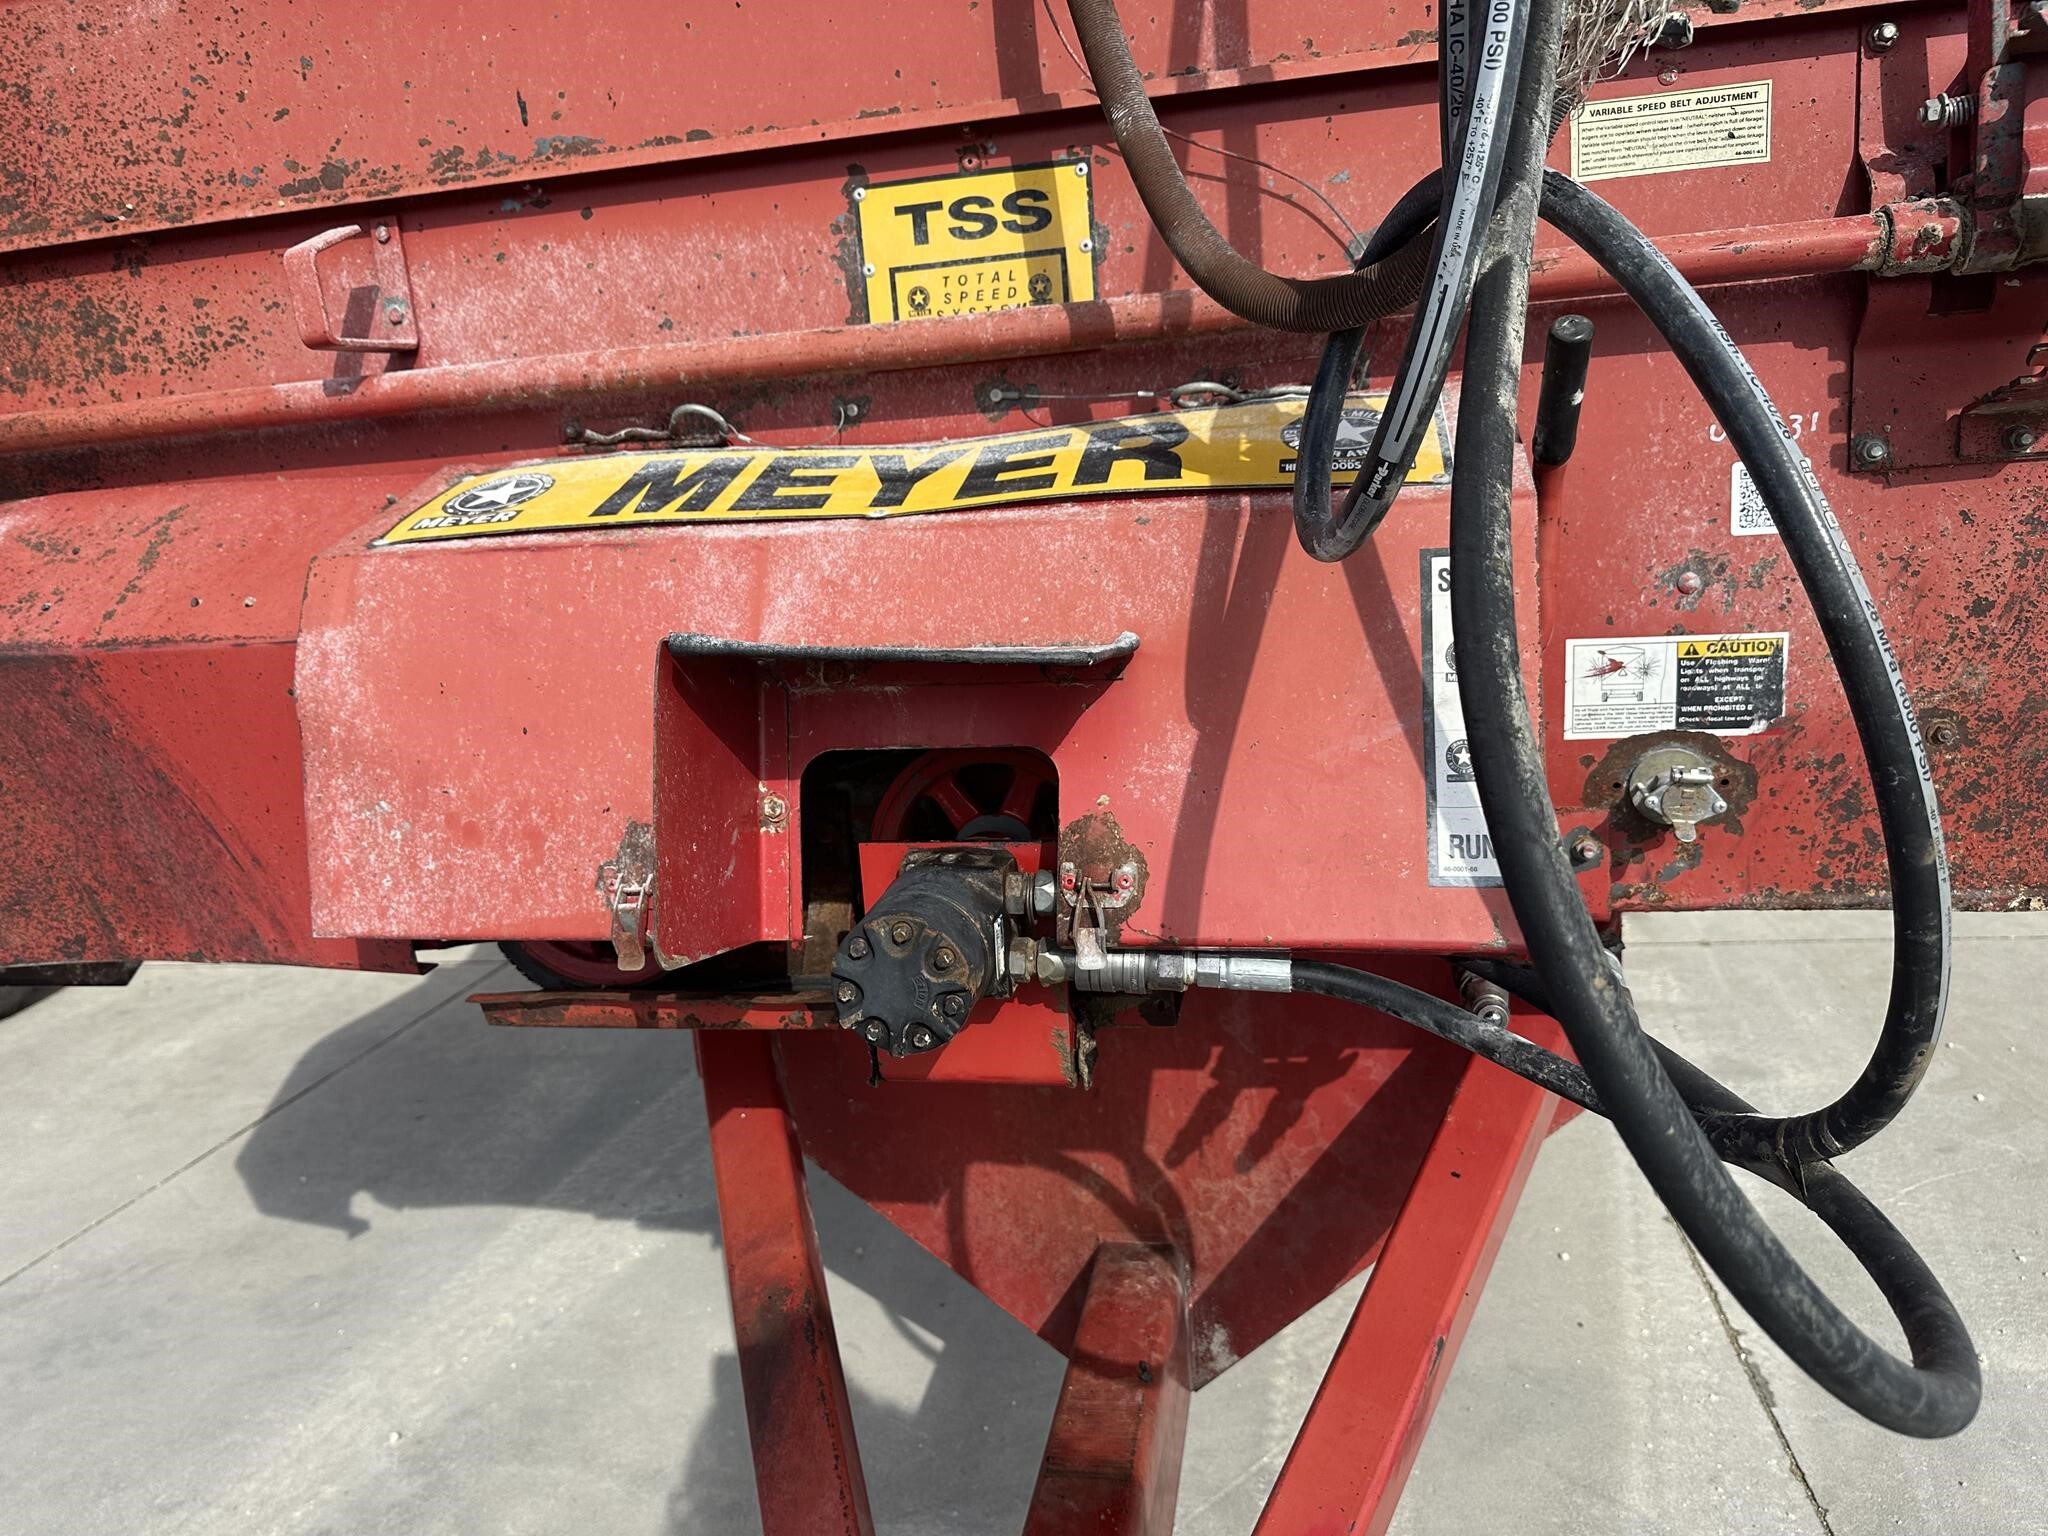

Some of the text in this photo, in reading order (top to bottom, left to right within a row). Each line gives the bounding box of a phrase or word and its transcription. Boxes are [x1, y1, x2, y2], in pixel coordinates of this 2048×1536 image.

[1484, 31, 1506, 71] PSI)
[1589, 91, 1759, 117] VARIABLE SPEED BELT ADJUSTMENT
[894, 189, 1052, 246] TSS
[1458, 208, 1466, 231] MADE
[1454, 232, 1461, 241] IN
[942, 270, 1016, 288] TOTAL
[944, 287, 1017, 304] SPEED
[588, 422, 1189, 517] MEYER
[1367, 462, 1389, 498] Parker
[412, 510, 517, 530] MEYER
[1707, 641, 1779, 654] CAUTION
[1714, 675, 1749, 683] highways
[1865, 600, 1878, 622] 28
[1877, 628, 1898, 672] MPa
[1913, 738, 1931, 782] PSI)
